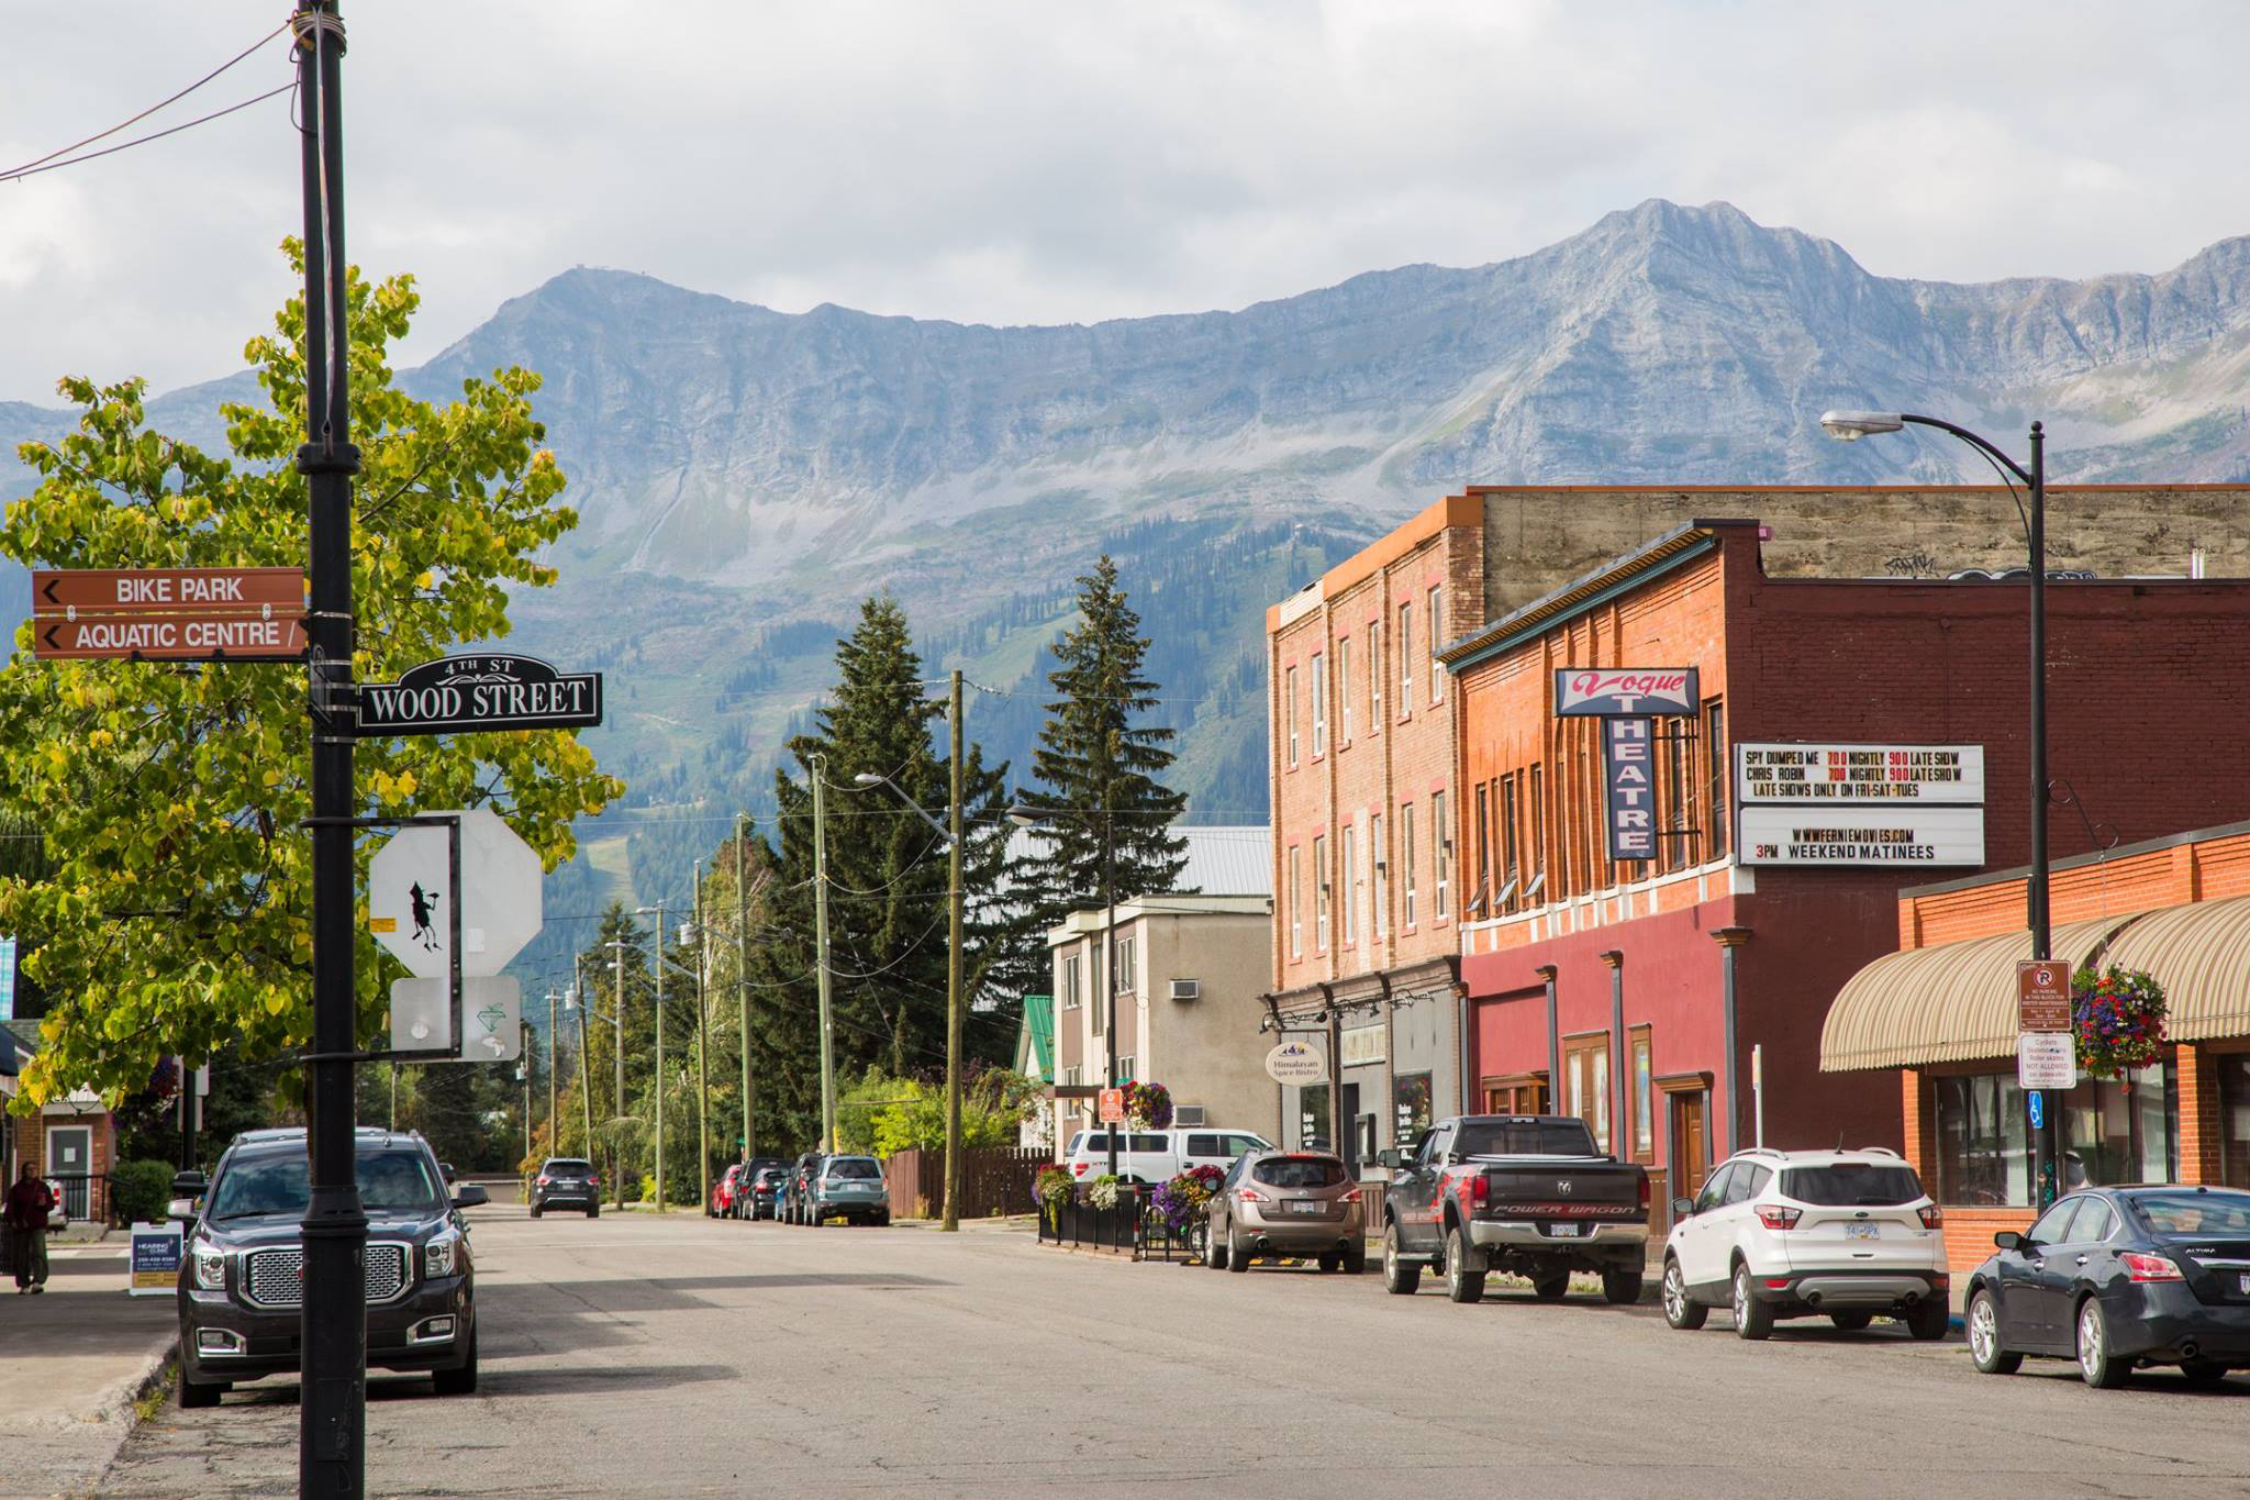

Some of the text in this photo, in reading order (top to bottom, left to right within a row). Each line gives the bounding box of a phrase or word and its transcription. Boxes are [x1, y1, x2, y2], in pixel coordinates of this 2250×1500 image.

[117, 577, 243, 603] BIKE PARK
[76, 623, 176, 649] AQUATIC
[185, 621, 280, 647] CENTRE
[444, 659, 515, 675] 4TH ST
[1572, 672, 1686, 698] Vogue
[369, 681, 587, 721] WOOD STREET
[1746, 751, 1960, 765] SPY DUMPED ME 700 NIGHTLY 900 LATE SHOW
[1611, 695, 1650, 850] THEATRE
[1746, 767, 1772, 781] CHRIS
[1778, 767, 1805, 781] ROBIN
[1828, 767, 1846, 781] 700
[1849, 767, 1885, 781] NIGHTLY
[1889, 767, 1908, 781] 900
[1753, 783, 1777, 797] LATE
[1779, 783, 1811, 797] SHOWS
[1814, 783, 1837, 797] ONLY
[1840, 783, 1853, 797] ON
[1756, 844, 1935, 859] 3PM WEEKEND MATINEES
[1273, 1060, 1318, 1069] Himalayan
[1493, 1205, 1636, 1214] POWER WAGON
